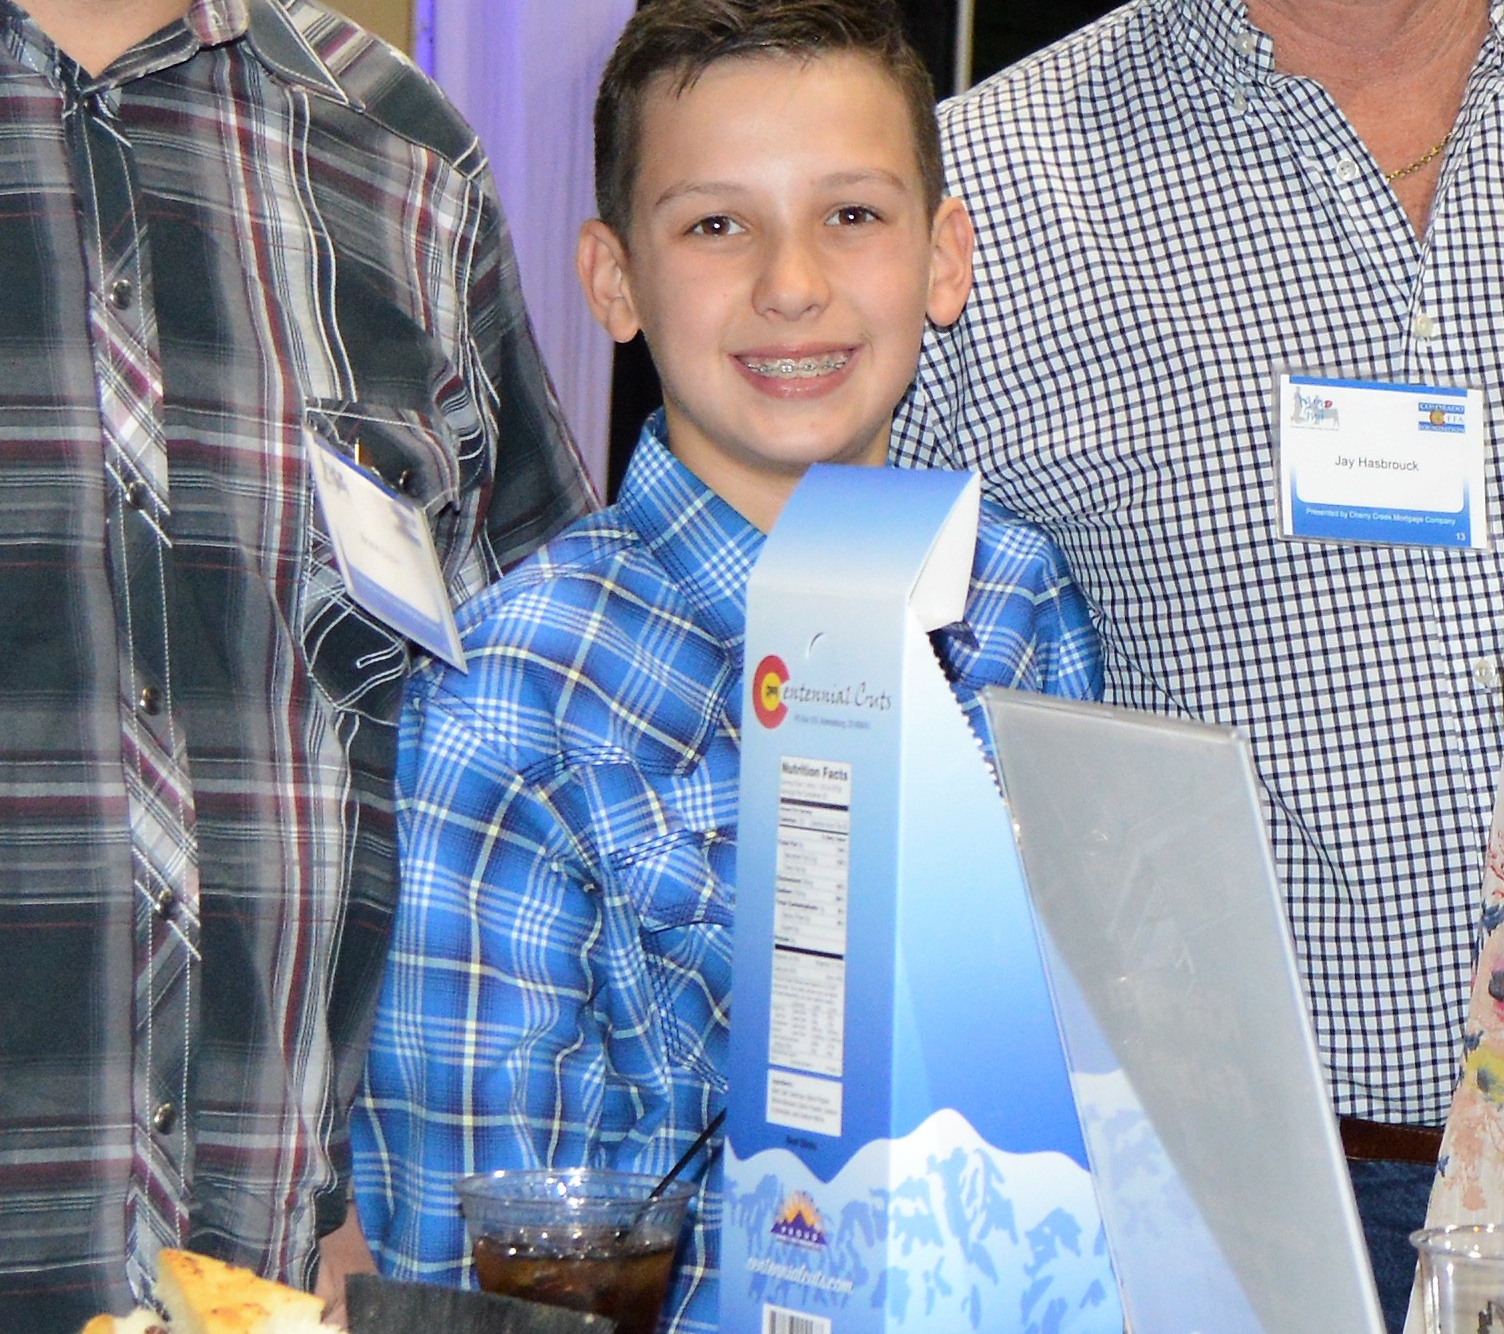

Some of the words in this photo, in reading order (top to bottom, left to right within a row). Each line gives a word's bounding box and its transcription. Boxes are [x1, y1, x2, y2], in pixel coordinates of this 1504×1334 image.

[1335, 455, 1354, 469] Jay
[1358, 456, 1419, 471] Hasbrouck
[1306, 507, 1339, 517] Presented
[1340, 510, 1348, 519] by
[1349, 510, 1371, 520] Cherry
[1425, 516, 1456, 526] Company
[782, 762, 820, 778] Nutrition
[822, 766, 848, 781] Facts
